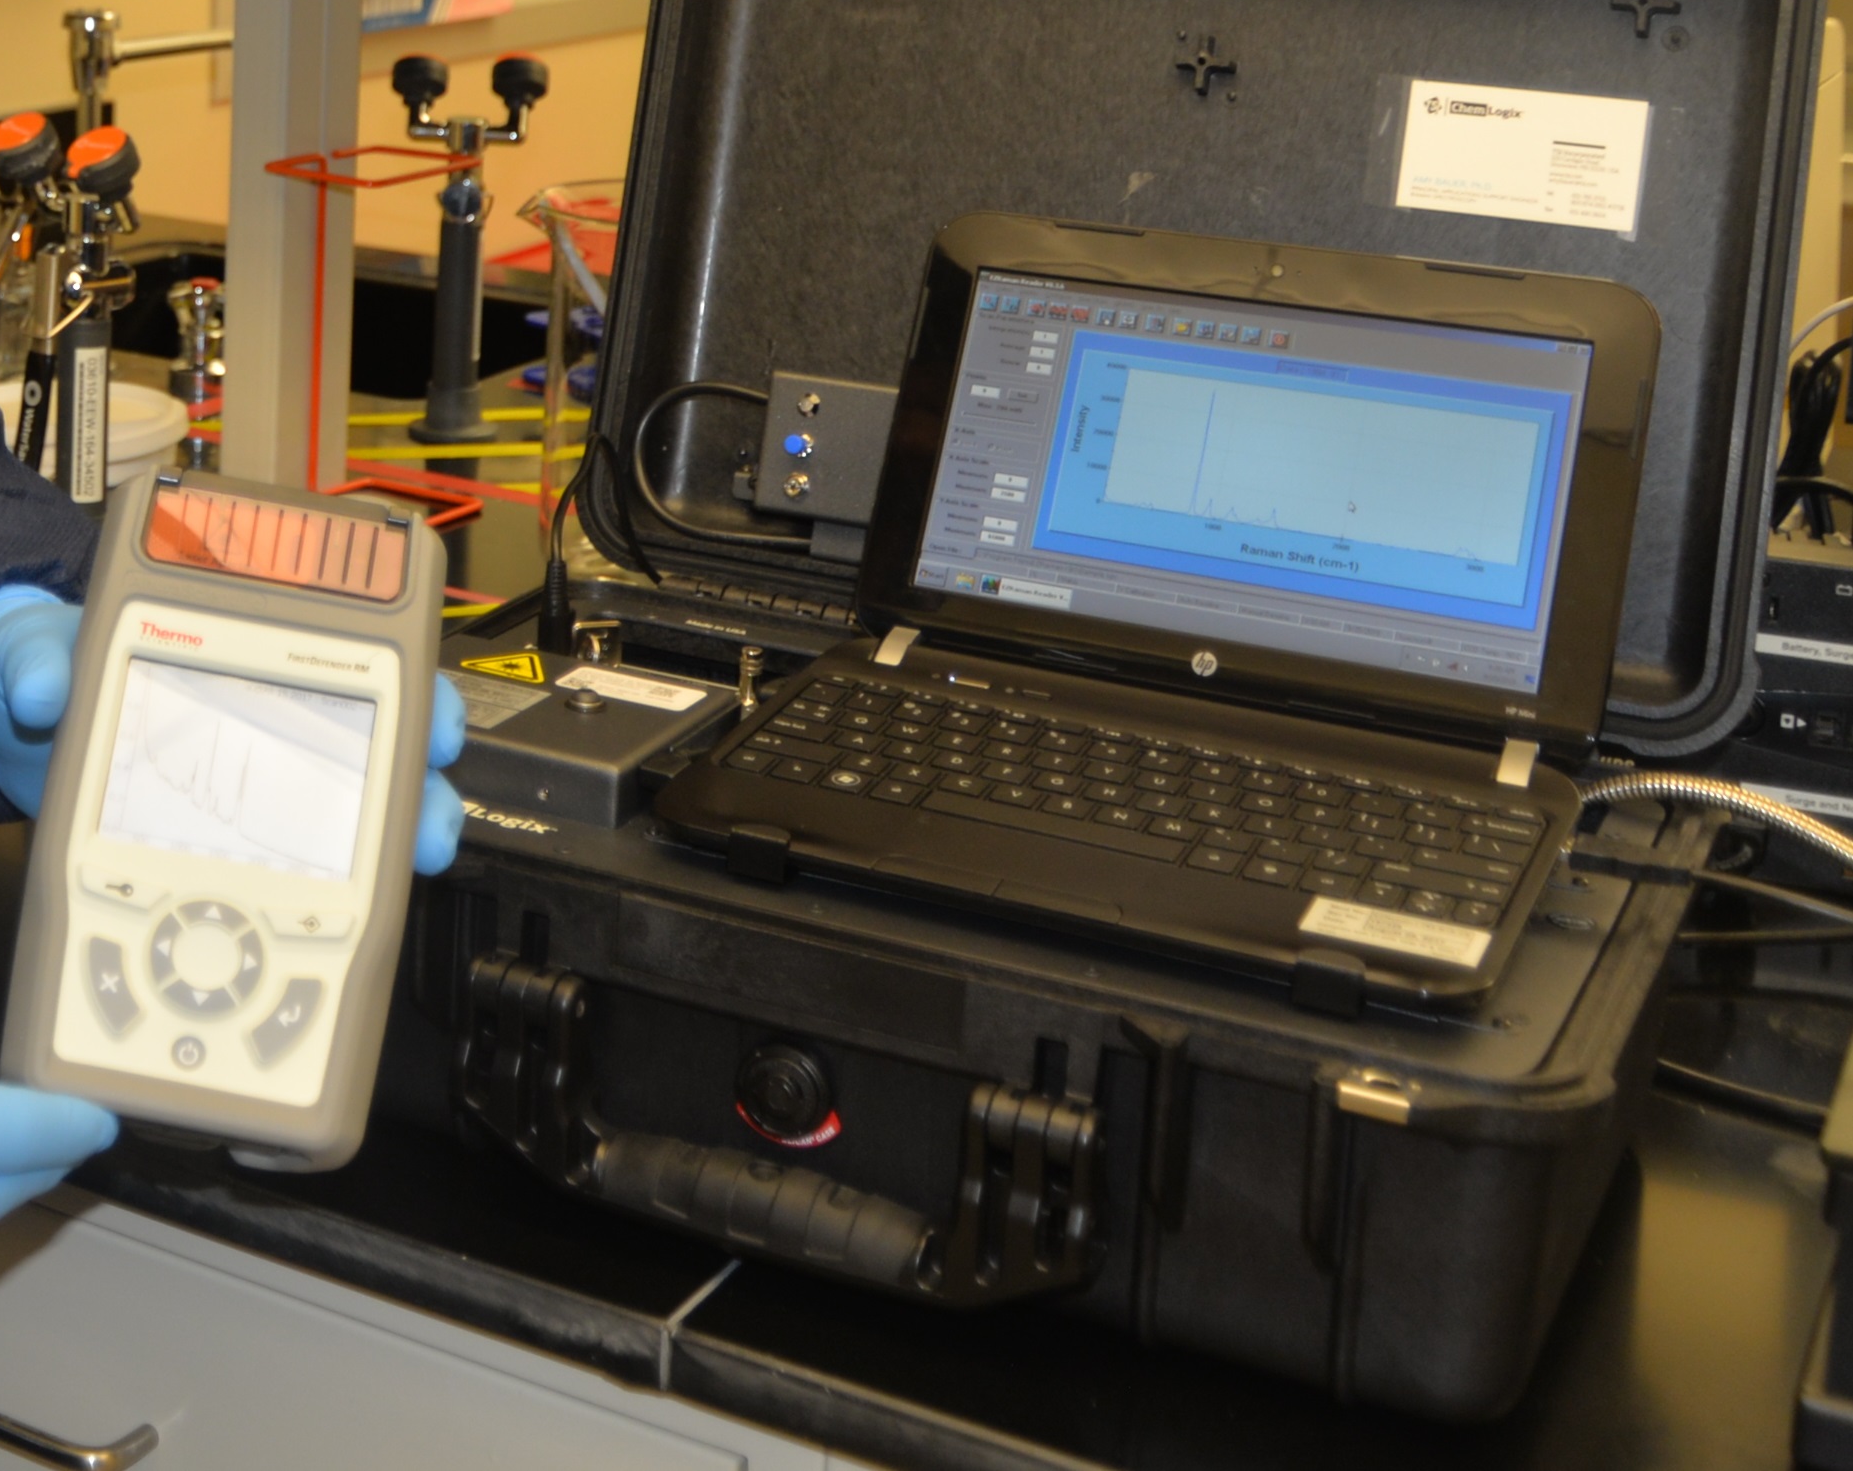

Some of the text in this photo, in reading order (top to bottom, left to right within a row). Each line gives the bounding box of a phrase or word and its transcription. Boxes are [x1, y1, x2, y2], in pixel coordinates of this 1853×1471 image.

[1071, 405, 1090, 453] Intensity
[1240, 543, 1359, 573] Raman Shift (cm-1)
[141, 621, 204, 647] Thermo
[1193, 651, 1216, 677] hp
